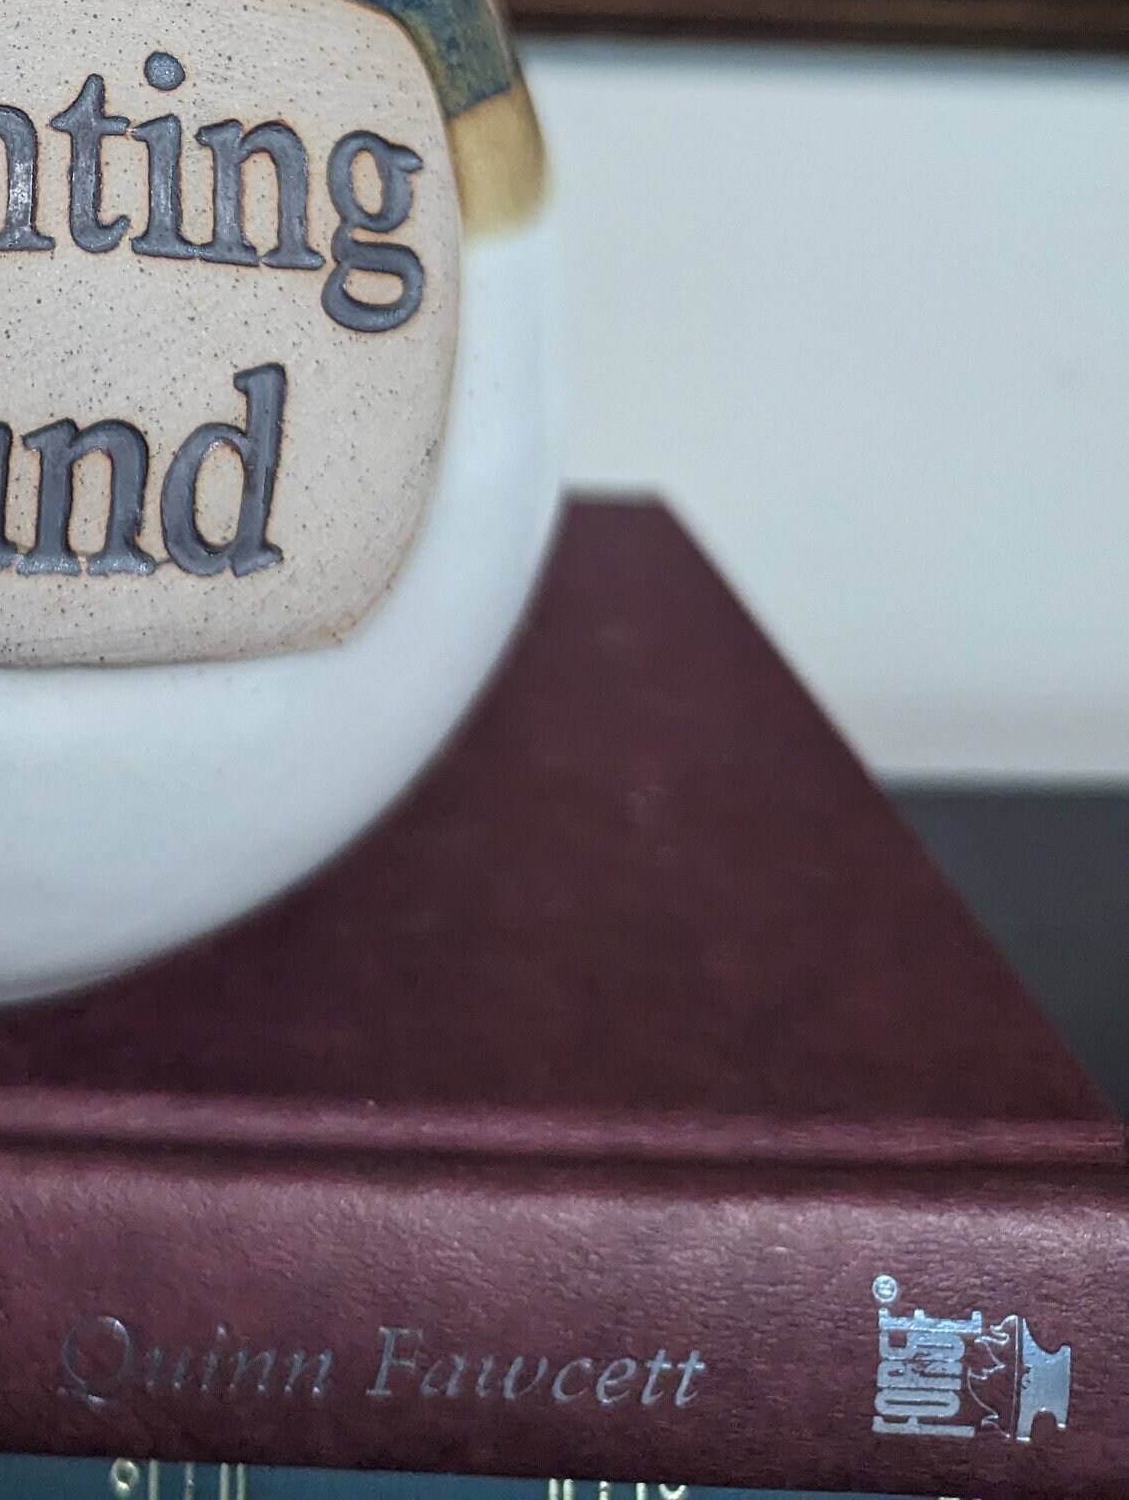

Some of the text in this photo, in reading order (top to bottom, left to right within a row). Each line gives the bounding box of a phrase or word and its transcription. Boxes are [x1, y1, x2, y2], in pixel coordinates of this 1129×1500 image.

[55, 1314, 707, 1411] Quinn Fawcett
[872, 1308, 983, 1438] FORGE
